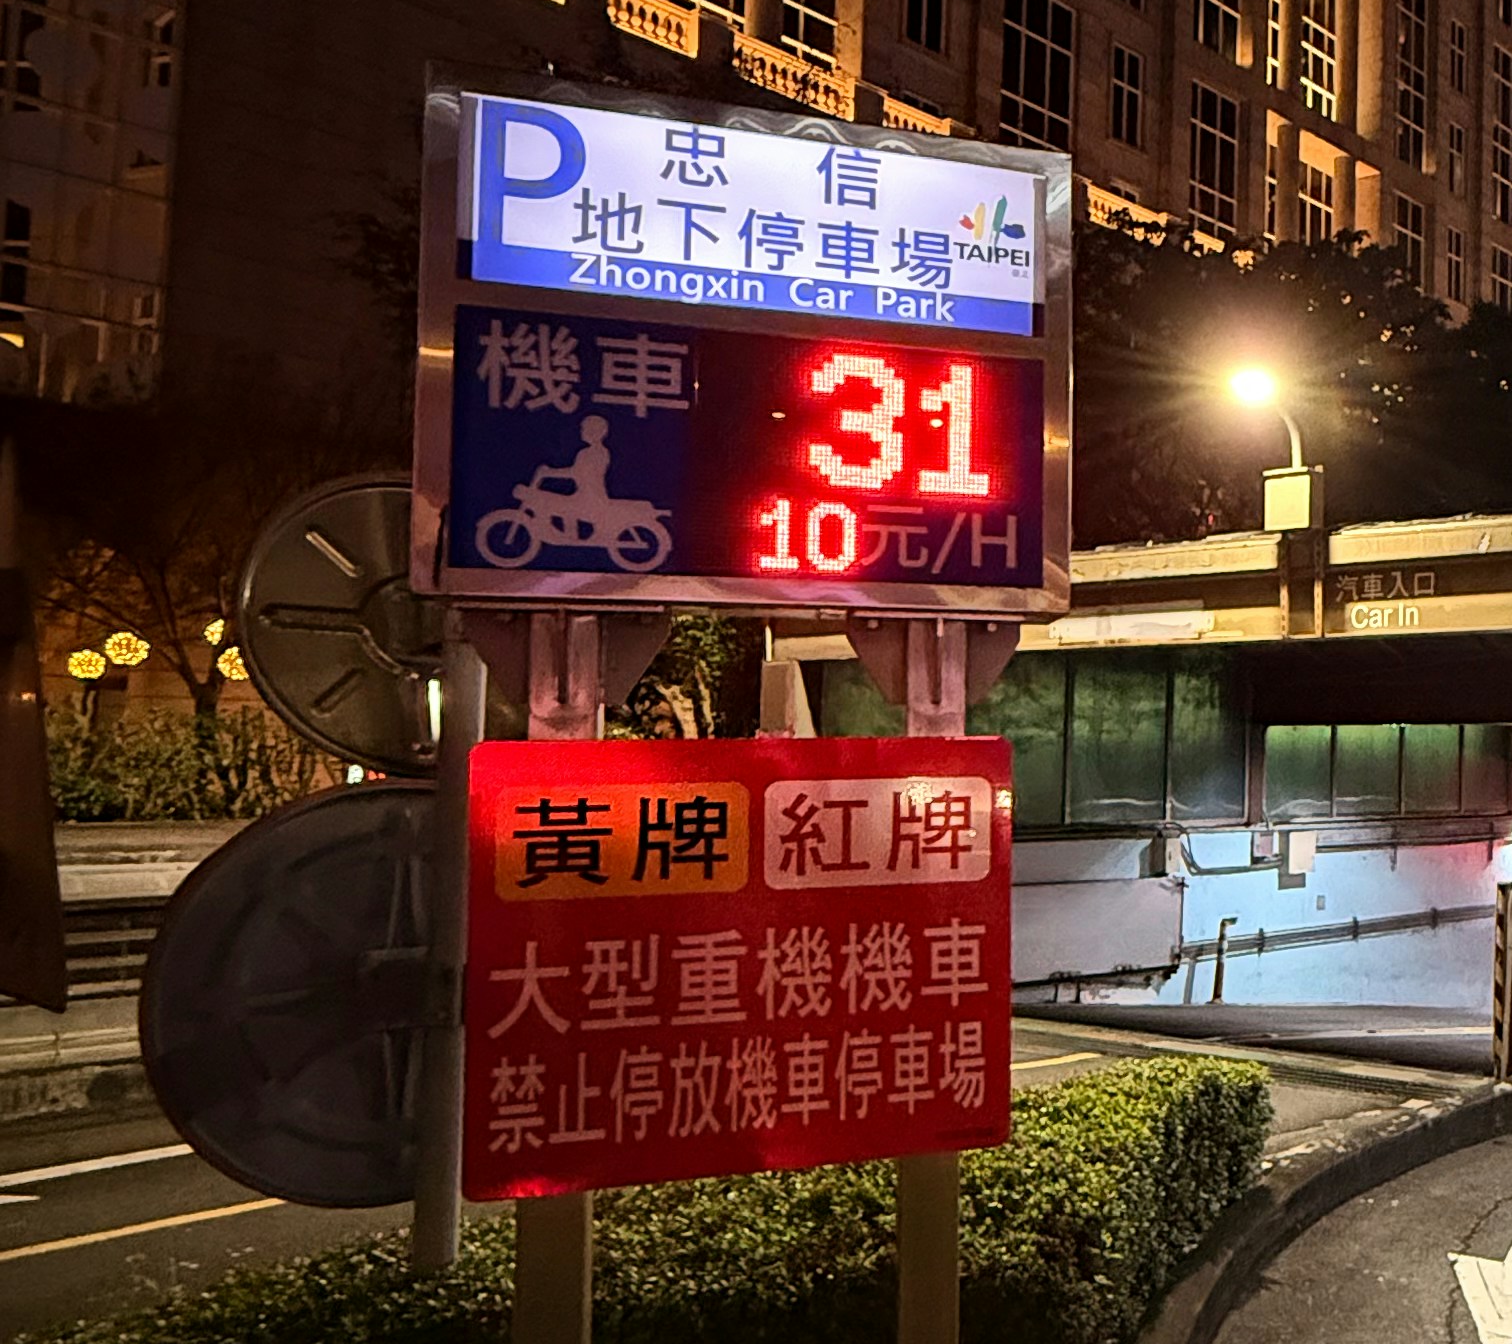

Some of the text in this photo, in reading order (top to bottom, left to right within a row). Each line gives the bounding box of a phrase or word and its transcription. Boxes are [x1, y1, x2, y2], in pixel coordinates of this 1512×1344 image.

[476, 99, 586, 258] P
[569, 253, 955, 323] Zhongxin Car Park
[572, 188, 954, 291] 地下停車場
[953, 242, 1030, 267] TAIPEI
[477, 319, 690, 419] 機車
[807, 352, 991, 498] 31
[1336, 570, 1435, 602] 汽車入口
[1351, 602, 1419, 629] Car In
[512, 789, 974, 888] 黃牌 紅牌
[487, 917, 990, 1040] 大型重機機車
[488, 1020, 986, 1154] 禁止停放機車停車場
